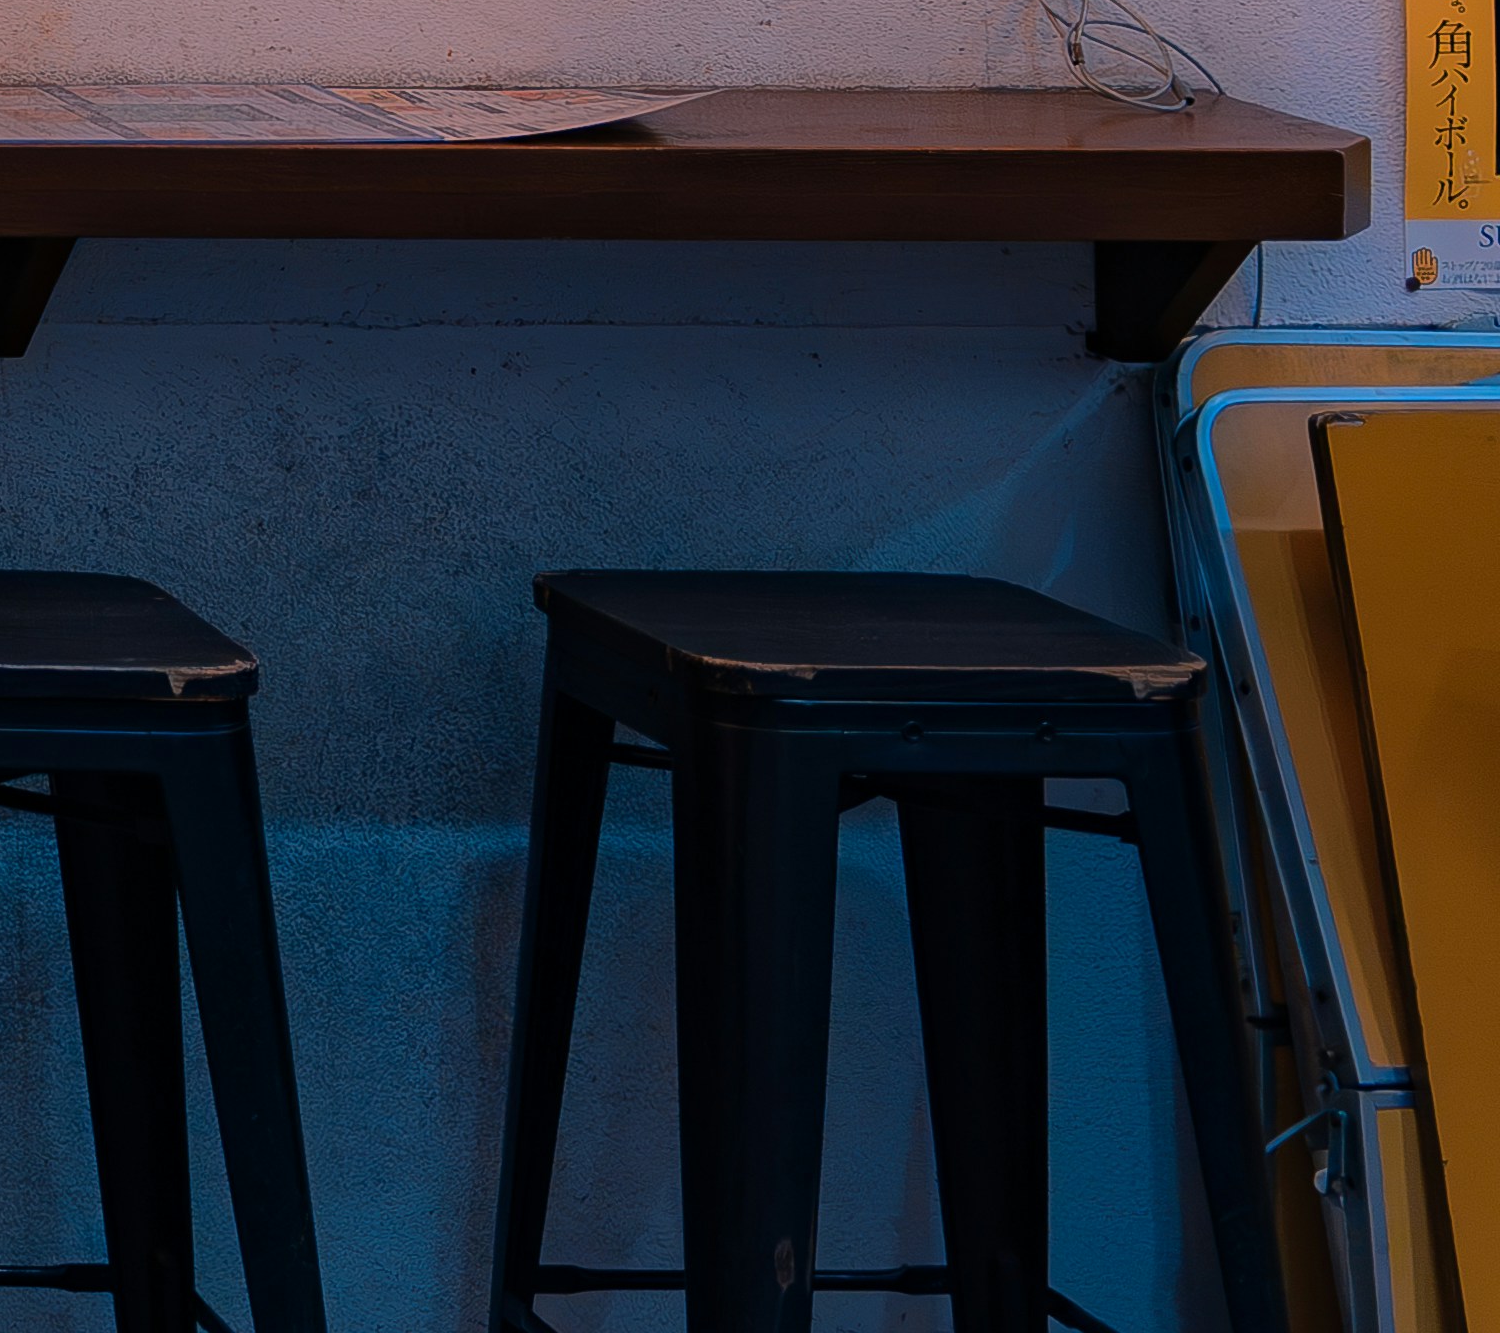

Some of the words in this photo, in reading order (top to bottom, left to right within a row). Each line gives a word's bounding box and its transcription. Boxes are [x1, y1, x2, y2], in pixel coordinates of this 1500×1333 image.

[1427, 18, 1474, 211] 角ハイボール。
